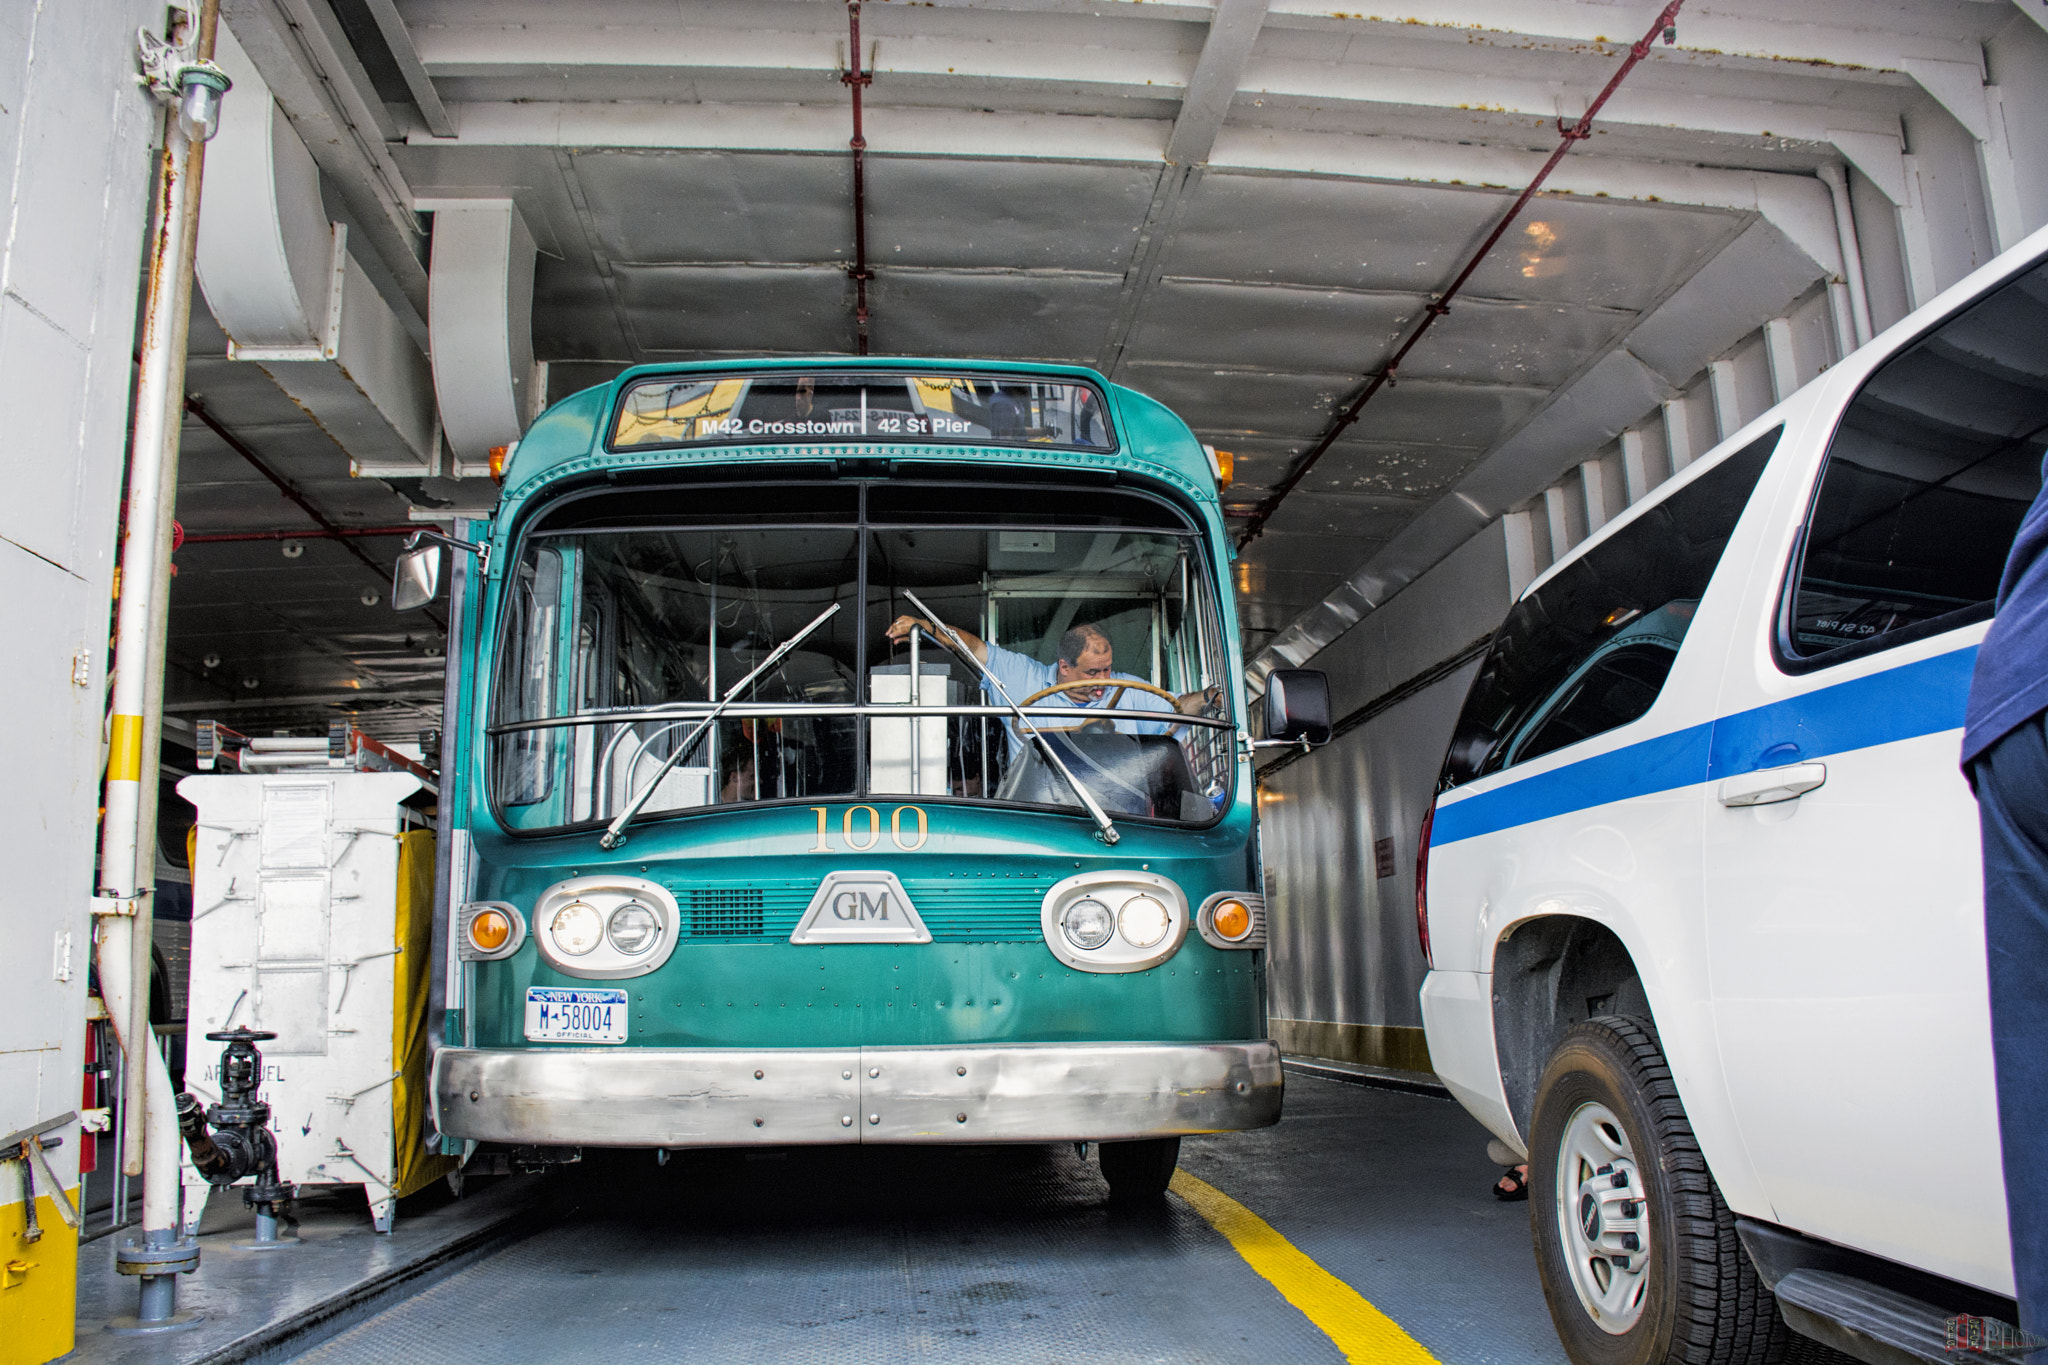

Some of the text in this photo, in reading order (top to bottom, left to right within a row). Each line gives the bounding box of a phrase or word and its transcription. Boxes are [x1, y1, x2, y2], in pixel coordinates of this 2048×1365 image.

[702, 418, 744, 435] M42
[749, 418, 855, 435] Crosstown
[877, 418, 901, 434] 42
[906, 418, 928, 434] St
[932, 418, 972, 434] Pier
[808, 805, 929, 854] 100
[832, 891, 890, 922] GM
[550, 991, 602, 1003] NEW YORK
